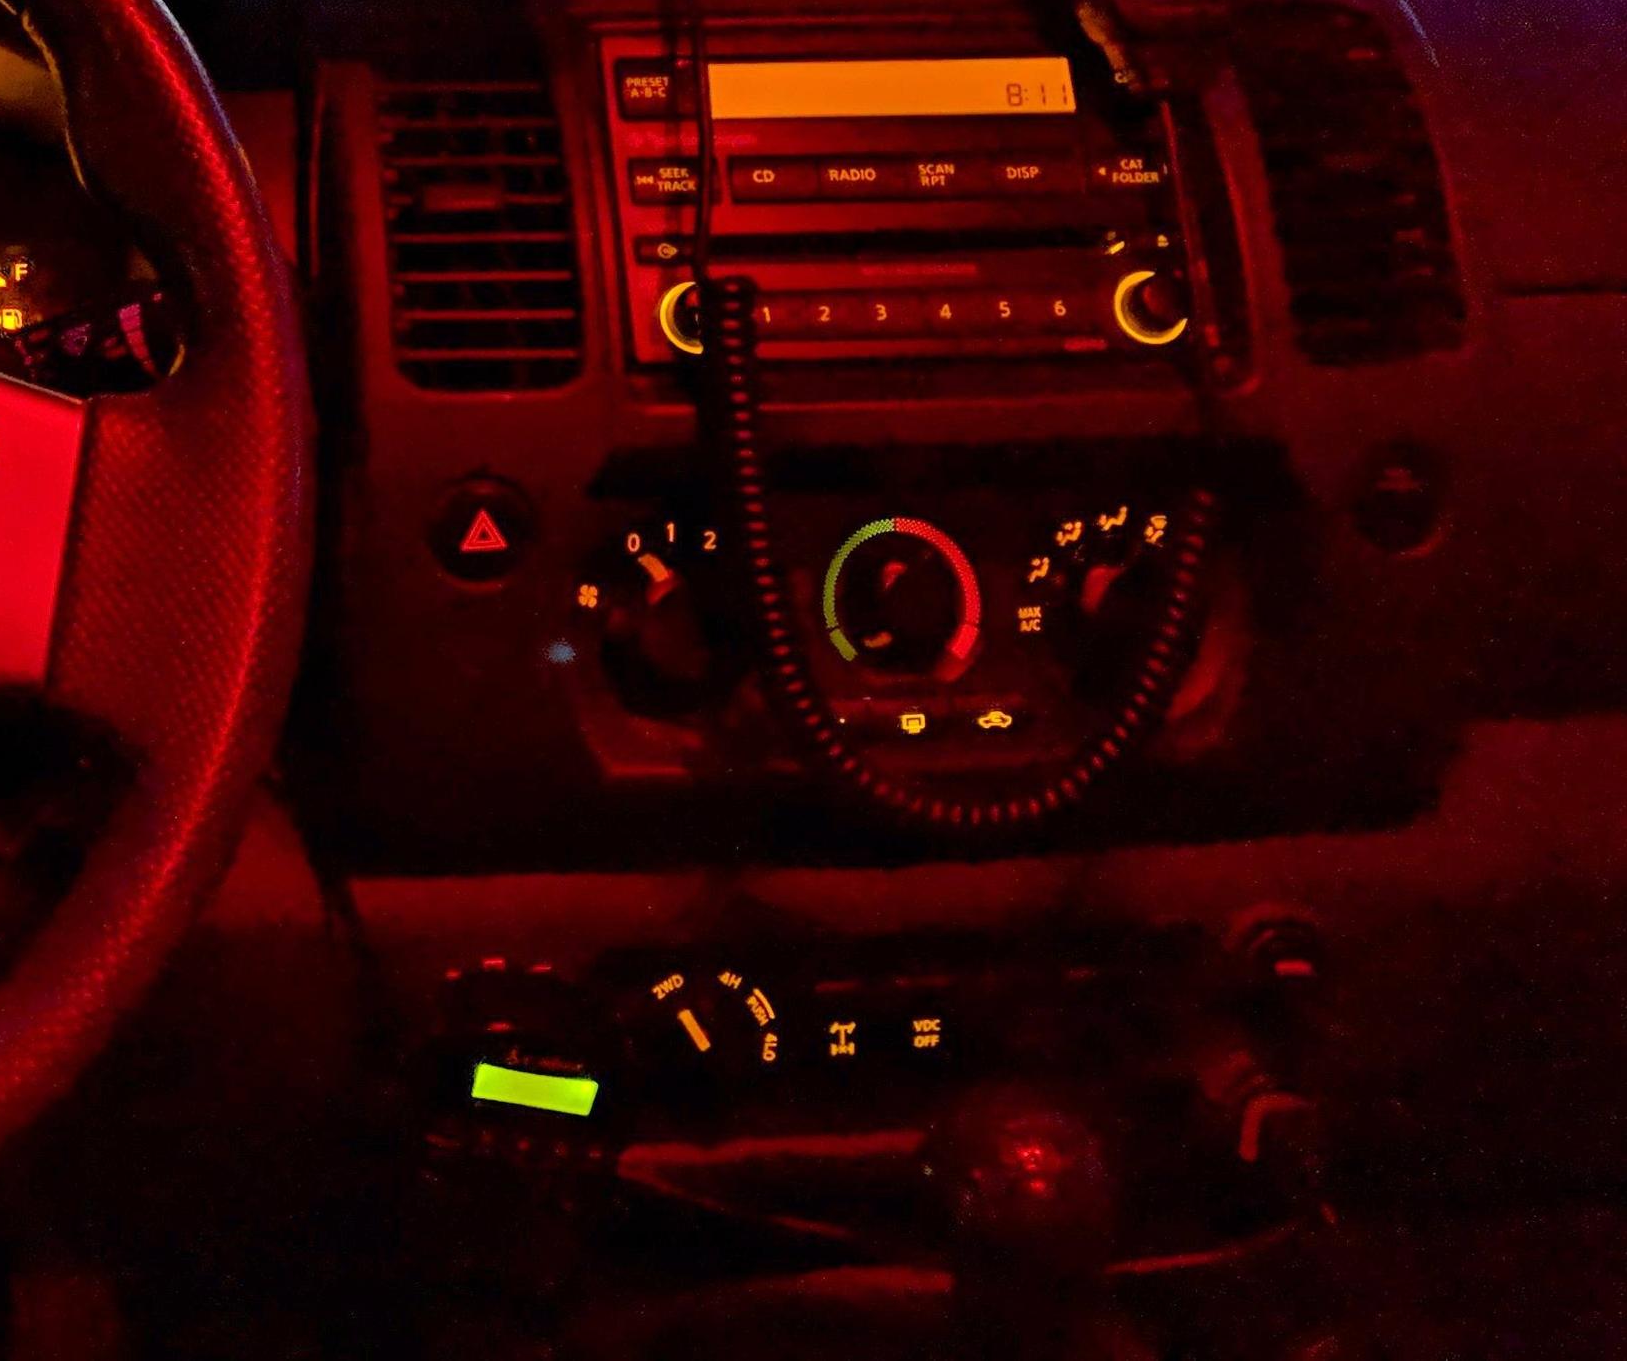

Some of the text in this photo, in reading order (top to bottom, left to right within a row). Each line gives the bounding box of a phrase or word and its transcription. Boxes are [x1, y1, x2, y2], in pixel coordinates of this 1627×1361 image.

[625, 77, 670, 88] PRESET
[1006, 82, 1069, 107] 8:11
[659, 167, 689, 179] SEEK
[828, 167, 877, 181] RADIO
[918, 163, 955, 175] SCAN
[1006, 167, 1039, 179] DISP
[752, 170, 775, 183] CD
[921, 174, 946, 186] RPT
[1112, 172, 1160, 183] FOLDER
[657, 179, 696, 192] TRACK
[15, 263, 28, 281] F
[762, 300, 1066, 323] 1 2 3 4 5 6
[666, 521, 676, 543] 1
[627, 532, 641, 553] 0
[703, 530, 717, 550] 2
[1018, 605, 1042, 619] MAX
[1020, 618, 1041, 632] A/C
[651, 973, 685, 1000] 2WD
[717, 971, 743, 990] 4H
[913, 1018, 941, 1032] VDC
[762, 1032, 778, 1061] 4LO
[914, 1034, 940, 1048] OFF
